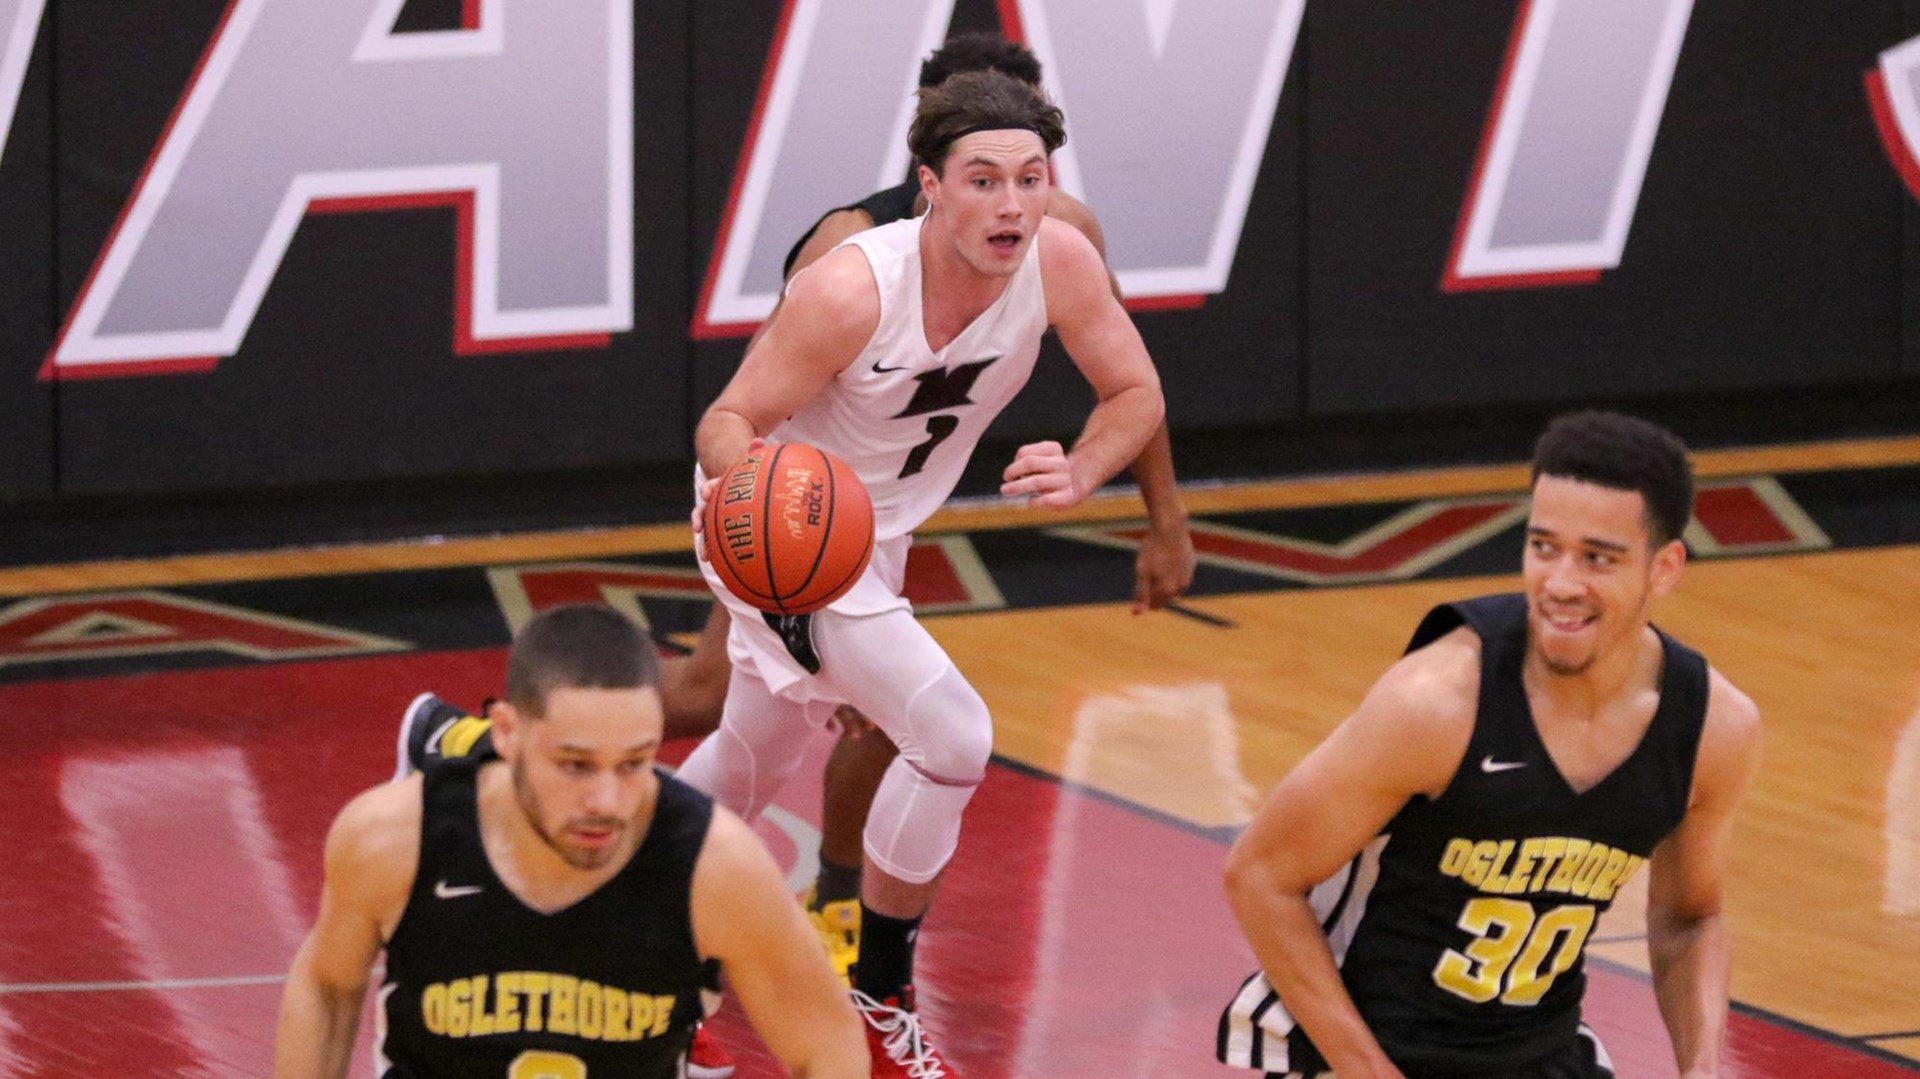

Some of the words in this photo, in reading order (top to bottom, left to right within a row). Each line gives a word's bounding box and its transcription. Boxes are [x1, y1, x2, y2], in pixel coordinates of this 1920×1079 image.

[898, 414, 960, 480] 1
[806, 481, 824, 527] ROCK
[724, 513, 755, 565] THE
[1431, 896, 1596, 1006] 30
[422, 971, 677, 1042] OGLETHORPE
